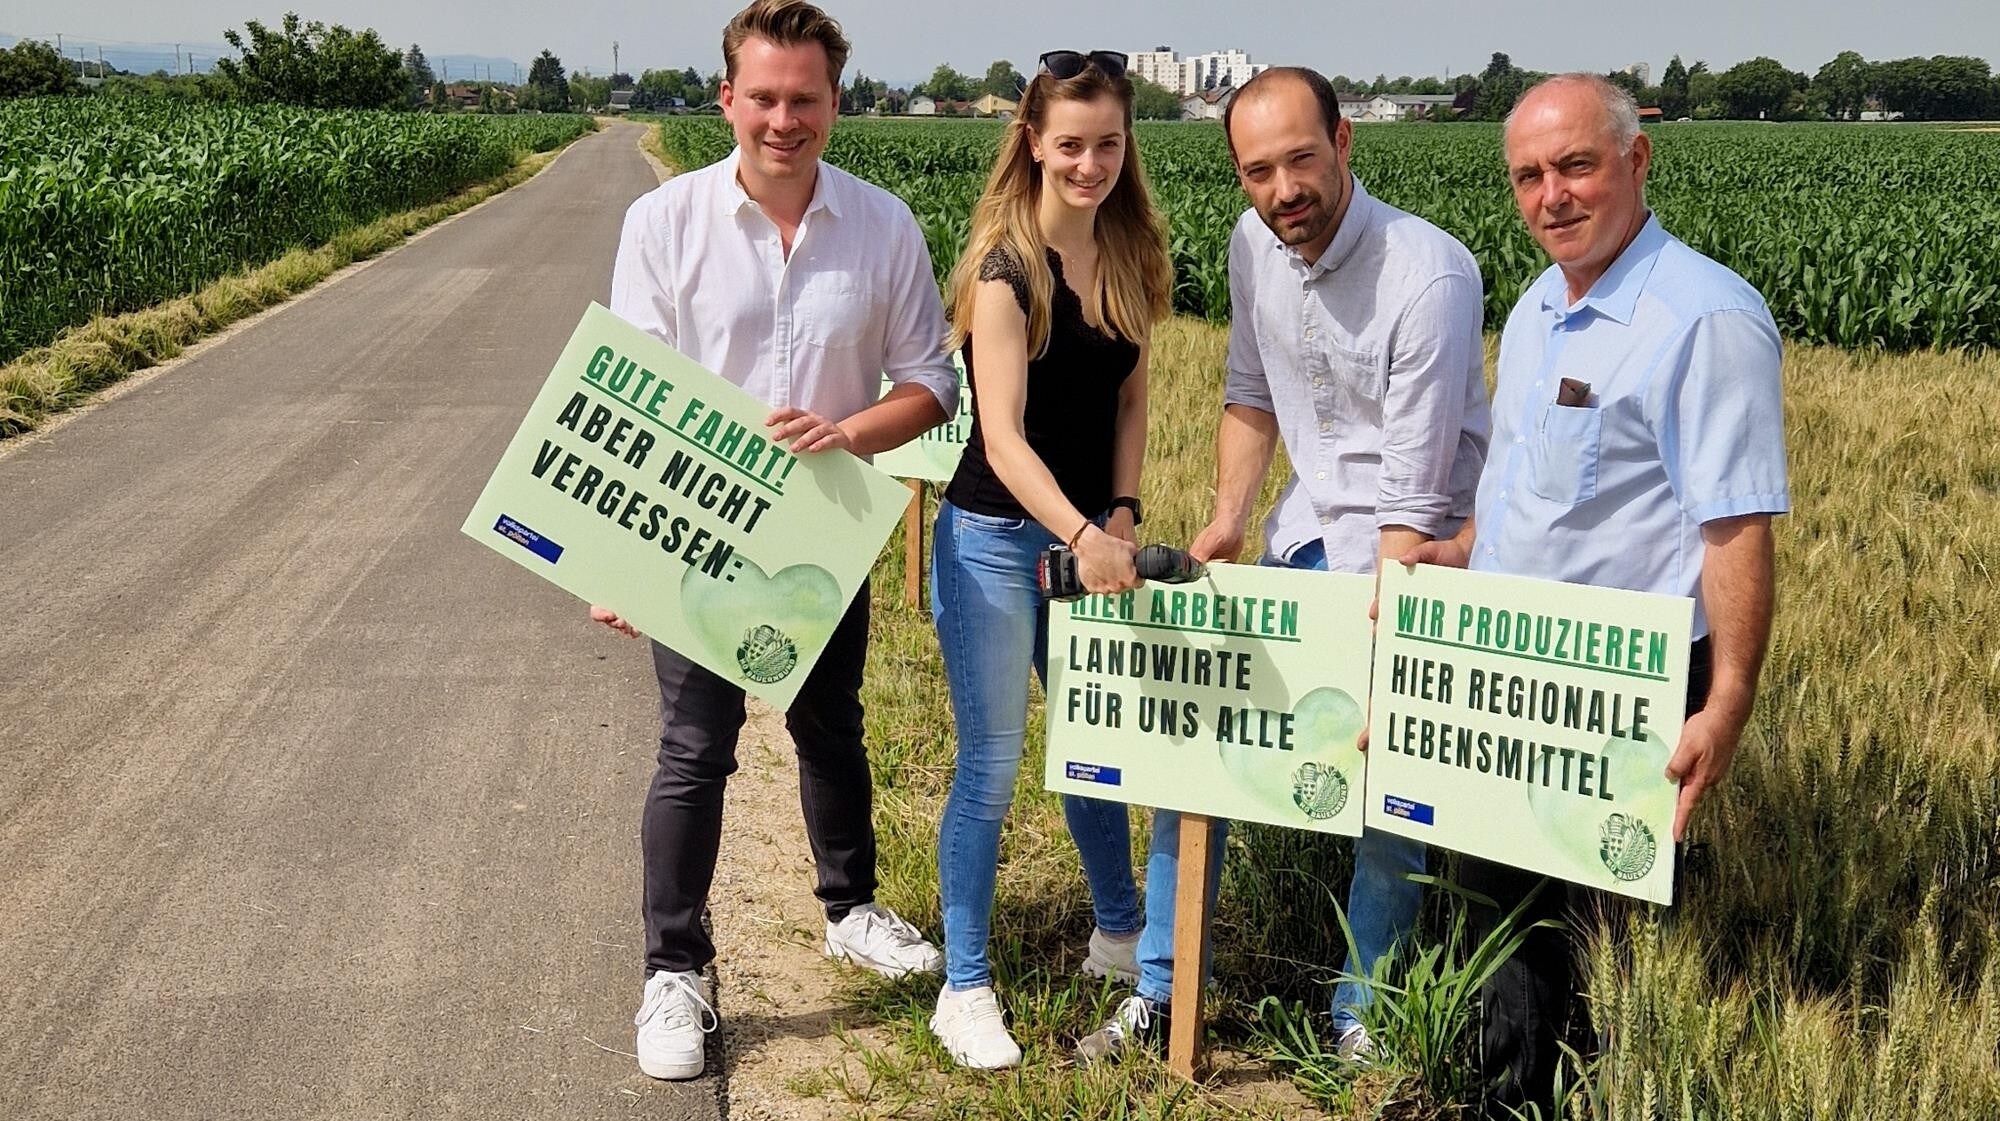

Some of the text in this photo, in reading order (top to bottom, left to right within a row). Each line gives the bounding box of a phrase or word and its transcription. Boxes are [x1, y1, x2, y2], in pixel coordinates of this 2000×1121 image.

[586, 345, 799, 489] GUTE FAHRT!
[555, 391, 772, 534] ABER NICHT
[502, 518, 539, 541] volkspartei
[530, 439, 744, 583] VERGESSEN:
[1149, 589, 1298, 637] ARBEITEN
[1397, 594, 1669, 675] WIR PRODUZIEREN
[745, 658, 795, 683] BAUERNBUND
[1069, 635, 1252, 691] LANDWIRTE
[1391, 654, 1650, 743] HIER REGIONALE
[1068, 682, 1295, 751] FÜR UNS ALLE
[1388, 712, 1614, 802] LEBENSMITTEL
